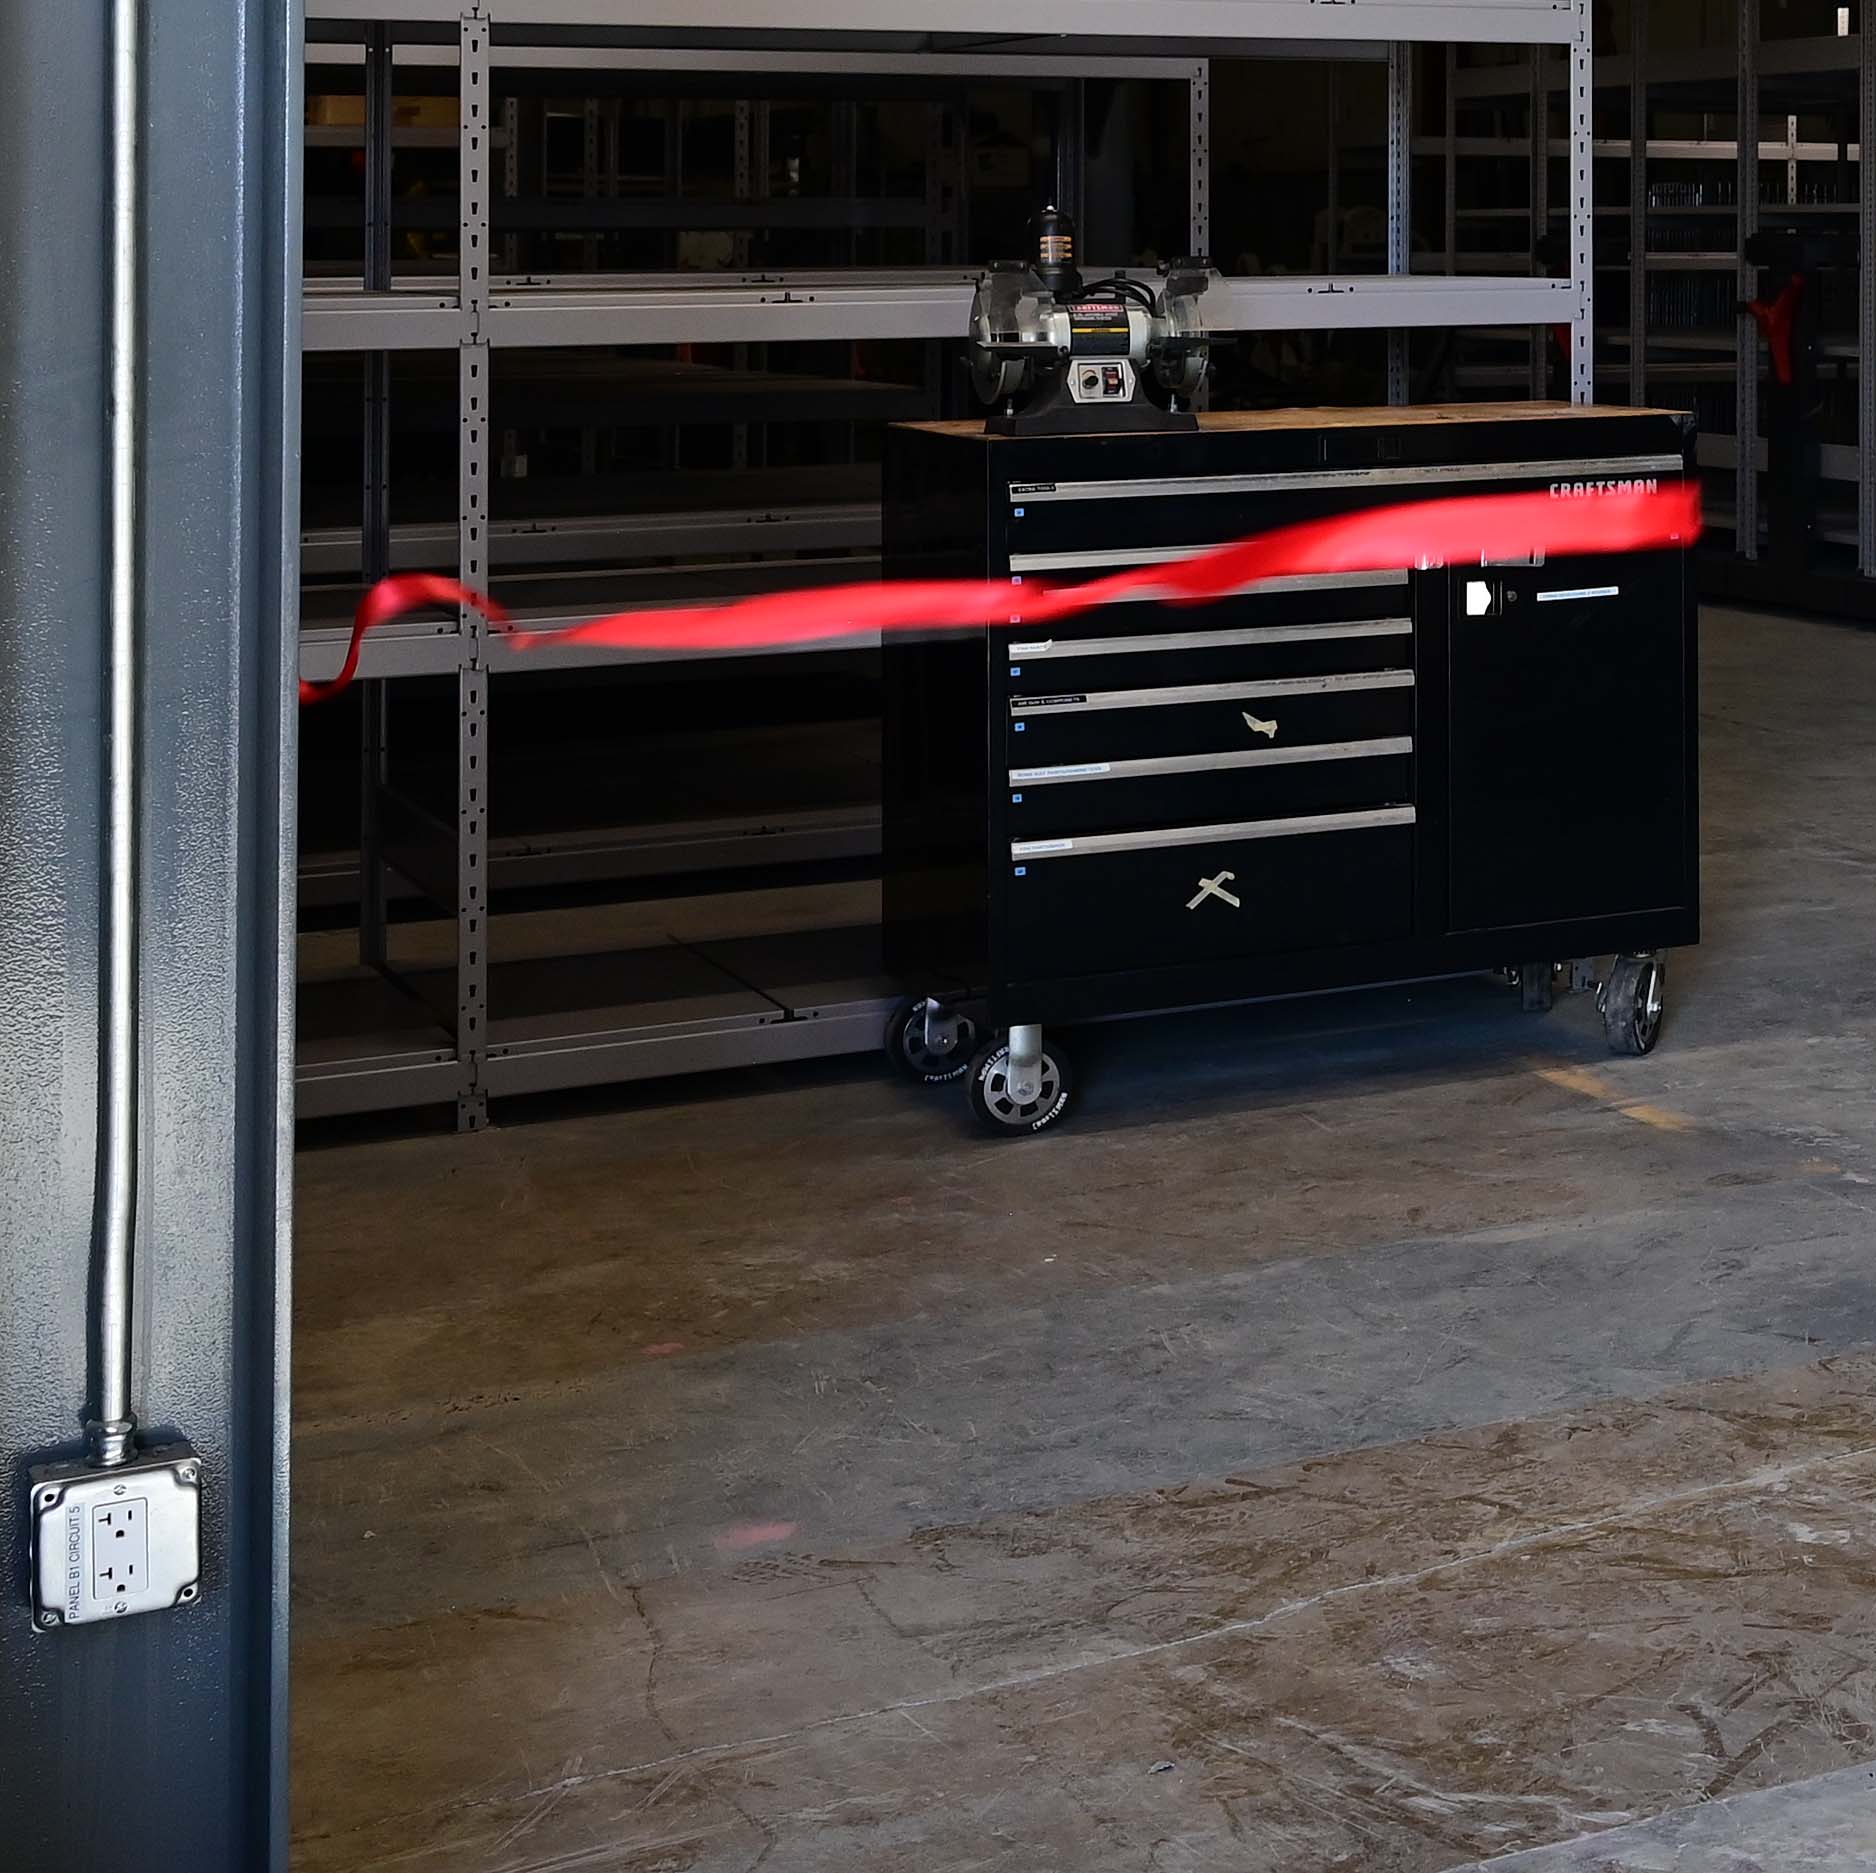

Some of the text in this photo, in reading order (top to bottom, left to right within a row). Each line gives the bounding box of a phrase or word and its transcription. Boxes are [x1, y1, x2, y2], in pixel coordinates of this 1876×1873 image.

[1550, 478, 1658, 499] CRAFTSMAN
[68, 1505, 81, 1620] PANEL B1 CIRCUIT 5
